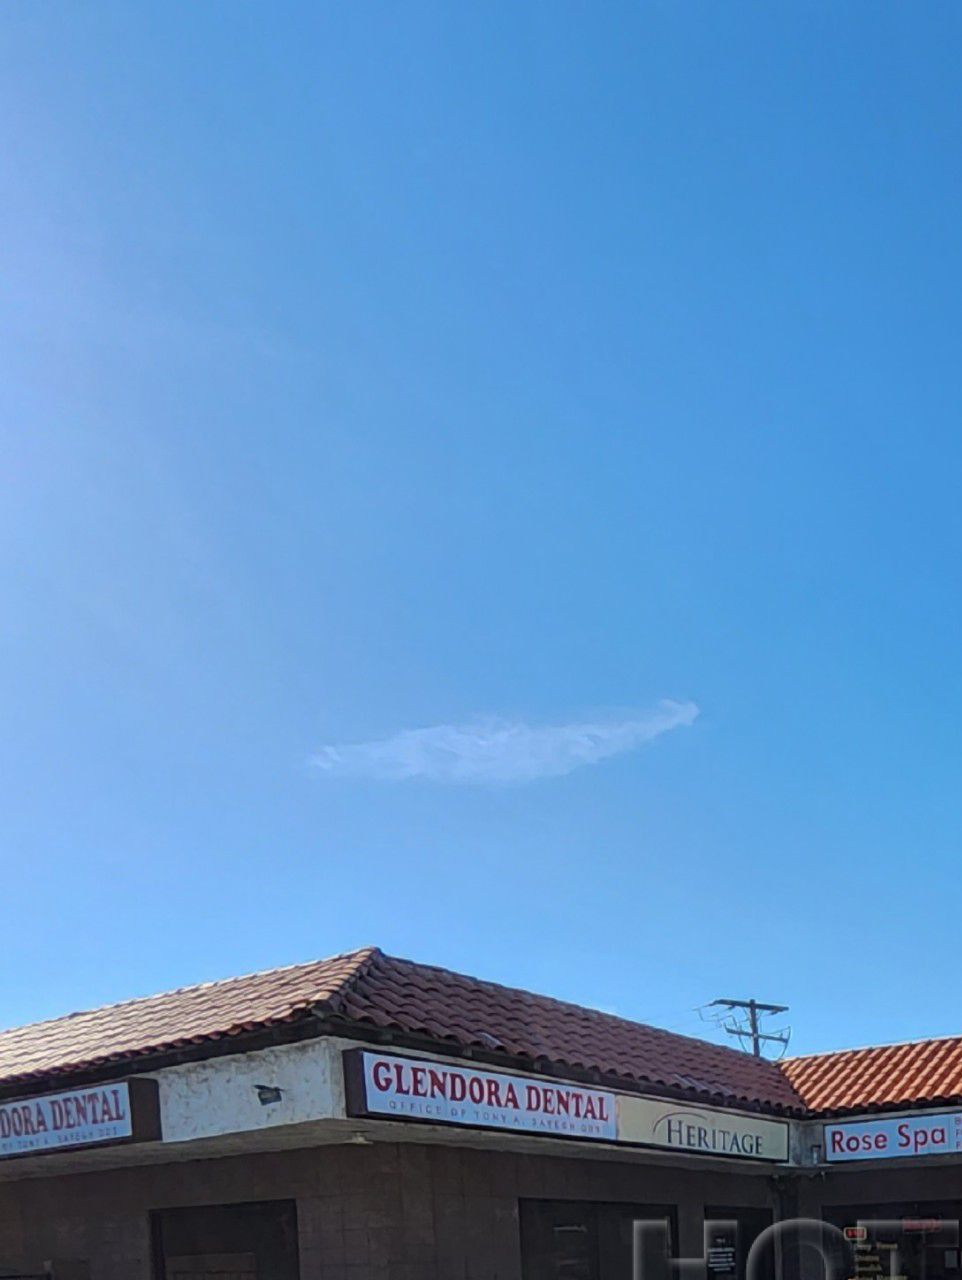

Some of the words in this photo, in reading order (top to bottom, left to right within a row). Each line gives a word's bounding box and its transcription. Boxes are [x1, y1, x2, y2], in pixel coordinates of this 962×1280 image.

[49, 1089, 125, 1131] DENTAL
[373, 1062, 520, 1110] GLENDORA
[526, 1085, 609, 1122] DENTAL
[389, 1101, 441, 1115] OFFICE
[451, 1108, 466, 1117] OF
[475, 1111, 506, 1123] TONY
[667, 1119, 763, 1155] HERITAGE
[831, 1130, 888, 1153] Rose
[898, 1124, 947, 1153] Spa
